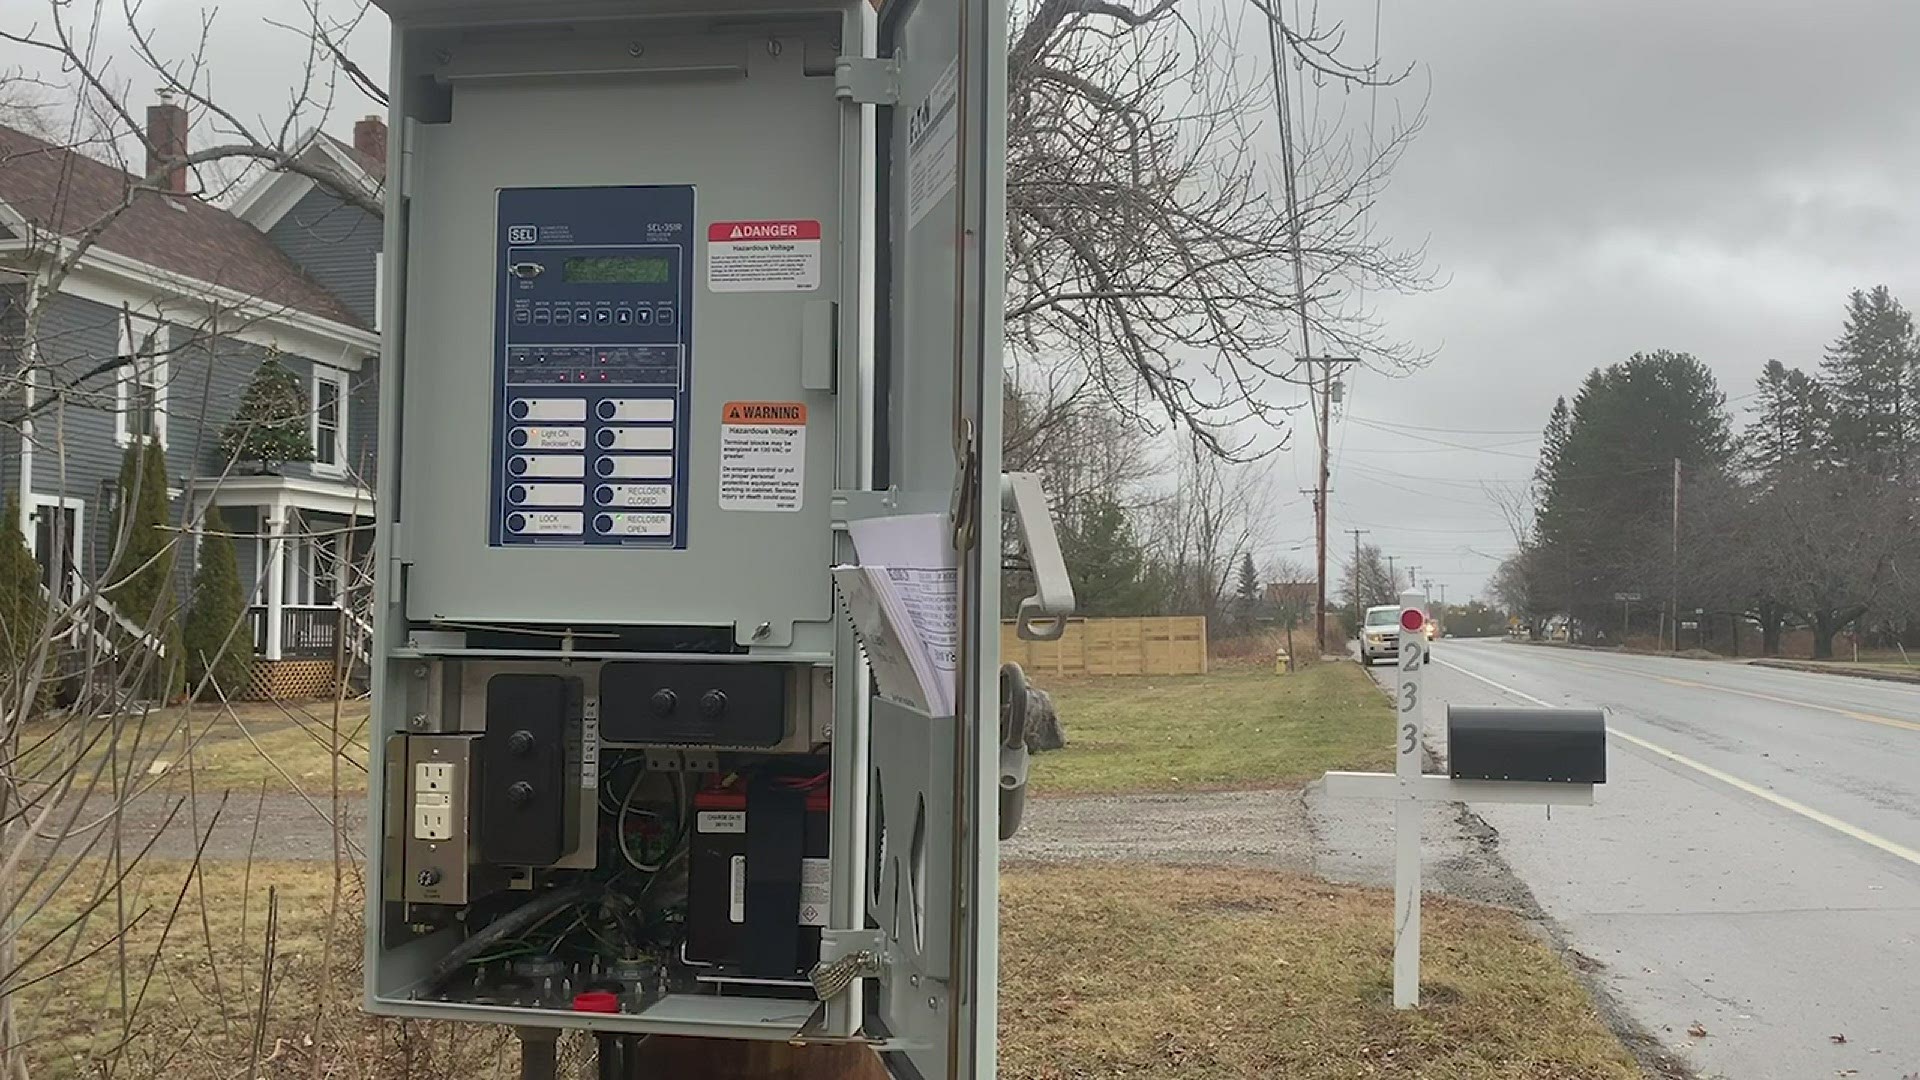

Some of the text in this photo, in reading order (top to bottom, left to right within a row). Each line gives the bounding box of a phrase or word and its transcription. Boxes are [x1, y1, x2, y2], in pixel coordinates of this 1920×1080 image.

[512, 229, 532, 240] SEL
[744, 225, 798, 236] DANGER
[743, 406, 799, 419] WARNING
[541, 429, 569, 439] Light ON
[770, 428, 798, 436] Voltage
[541, 439, 568, 447] Recloser
[628, 487, 667, 495] RECLOSER
[628, 496, 657, 505] CLOSED
[627, 516, 666, 524] RECLOSER
